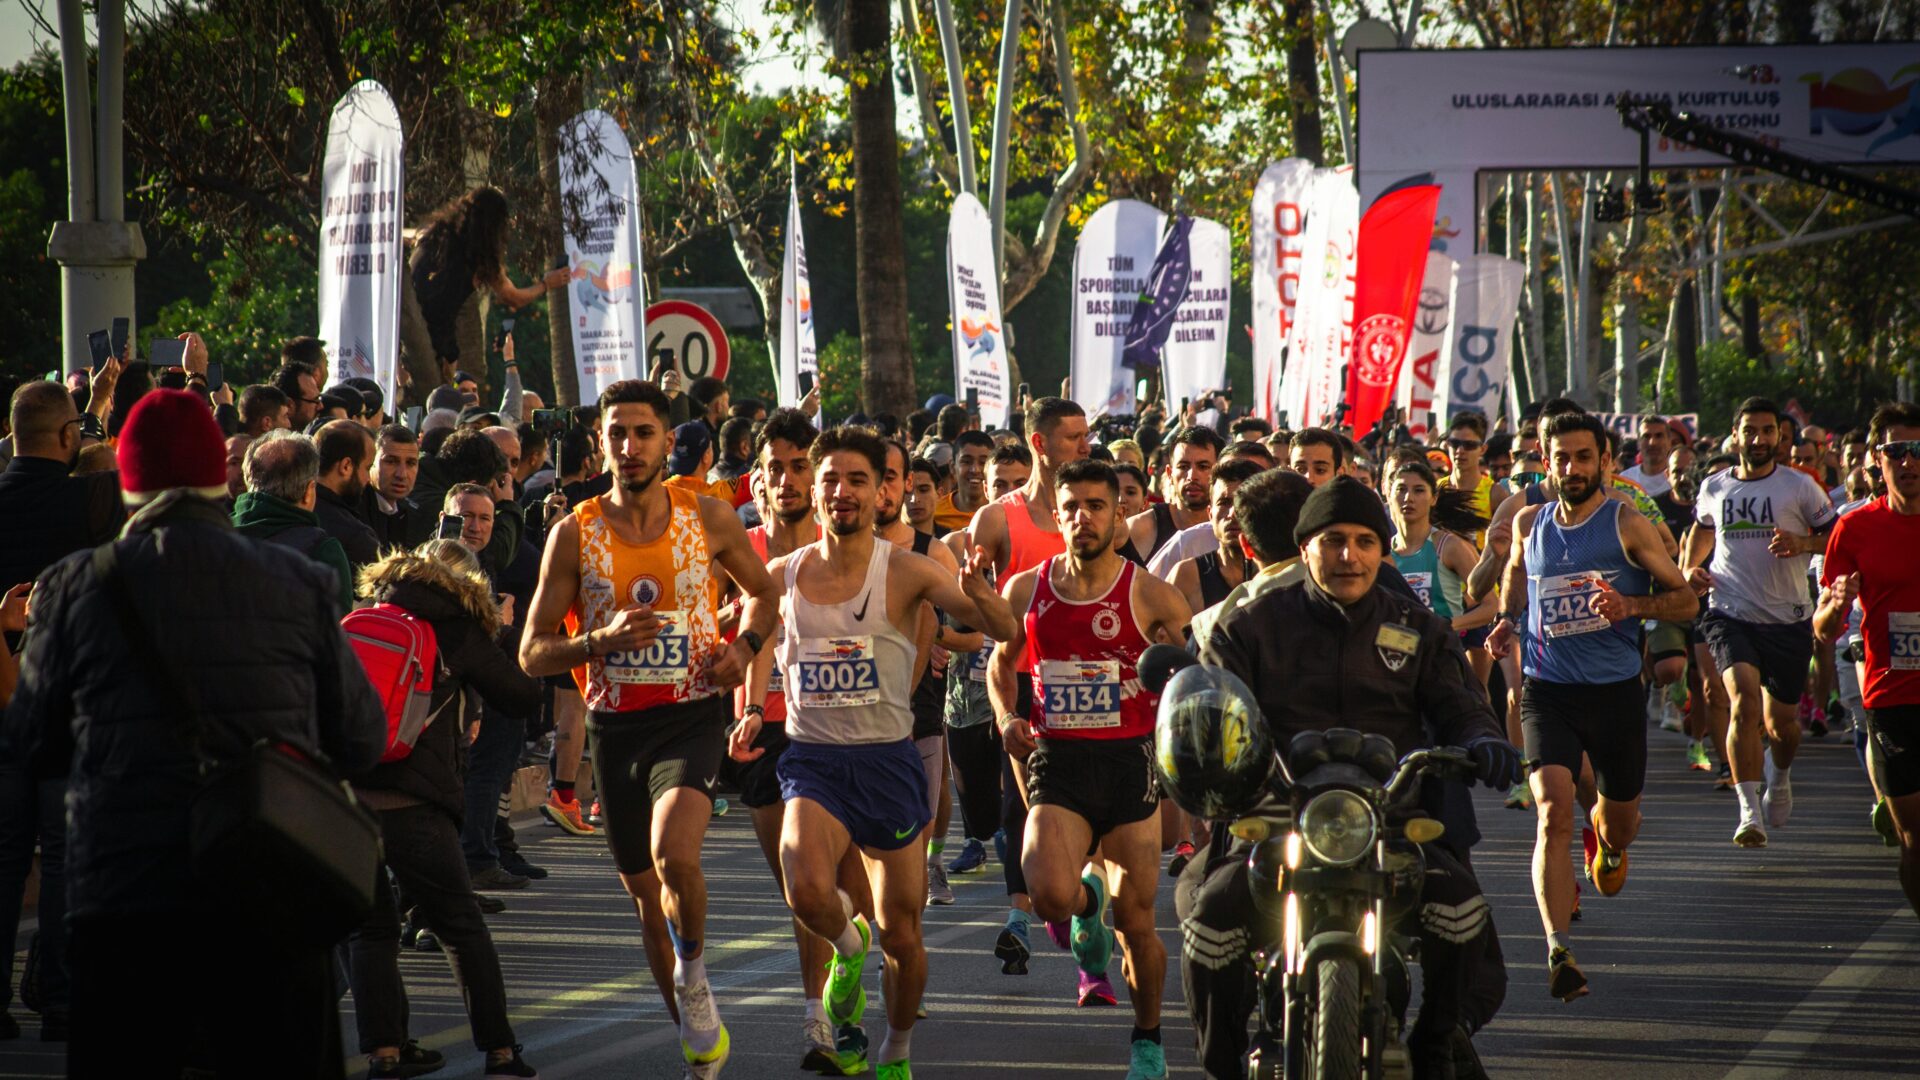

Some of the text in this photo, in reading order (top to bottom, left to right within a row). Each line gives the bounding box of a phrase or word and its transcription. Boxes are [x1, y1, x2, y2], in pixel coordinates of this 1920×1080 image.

[1452, 91, 1781, 108] ULUSLARARASI AANA KURTULUŞ
[1107, 254, 1135, 271] TÜM
[1274, 201, 1302, 339] TOTO
[1079, 278, 1146, 293] SPORCULA
[1086, 300, 1135, 317] BAŞARI
[1174, 308, 1224, 324] AŞARILAR
[1095, 321, 1130, 337] DİLE
[803, 662, 874, 691] 3002
[1050, 685, 1113, 712] 3134
